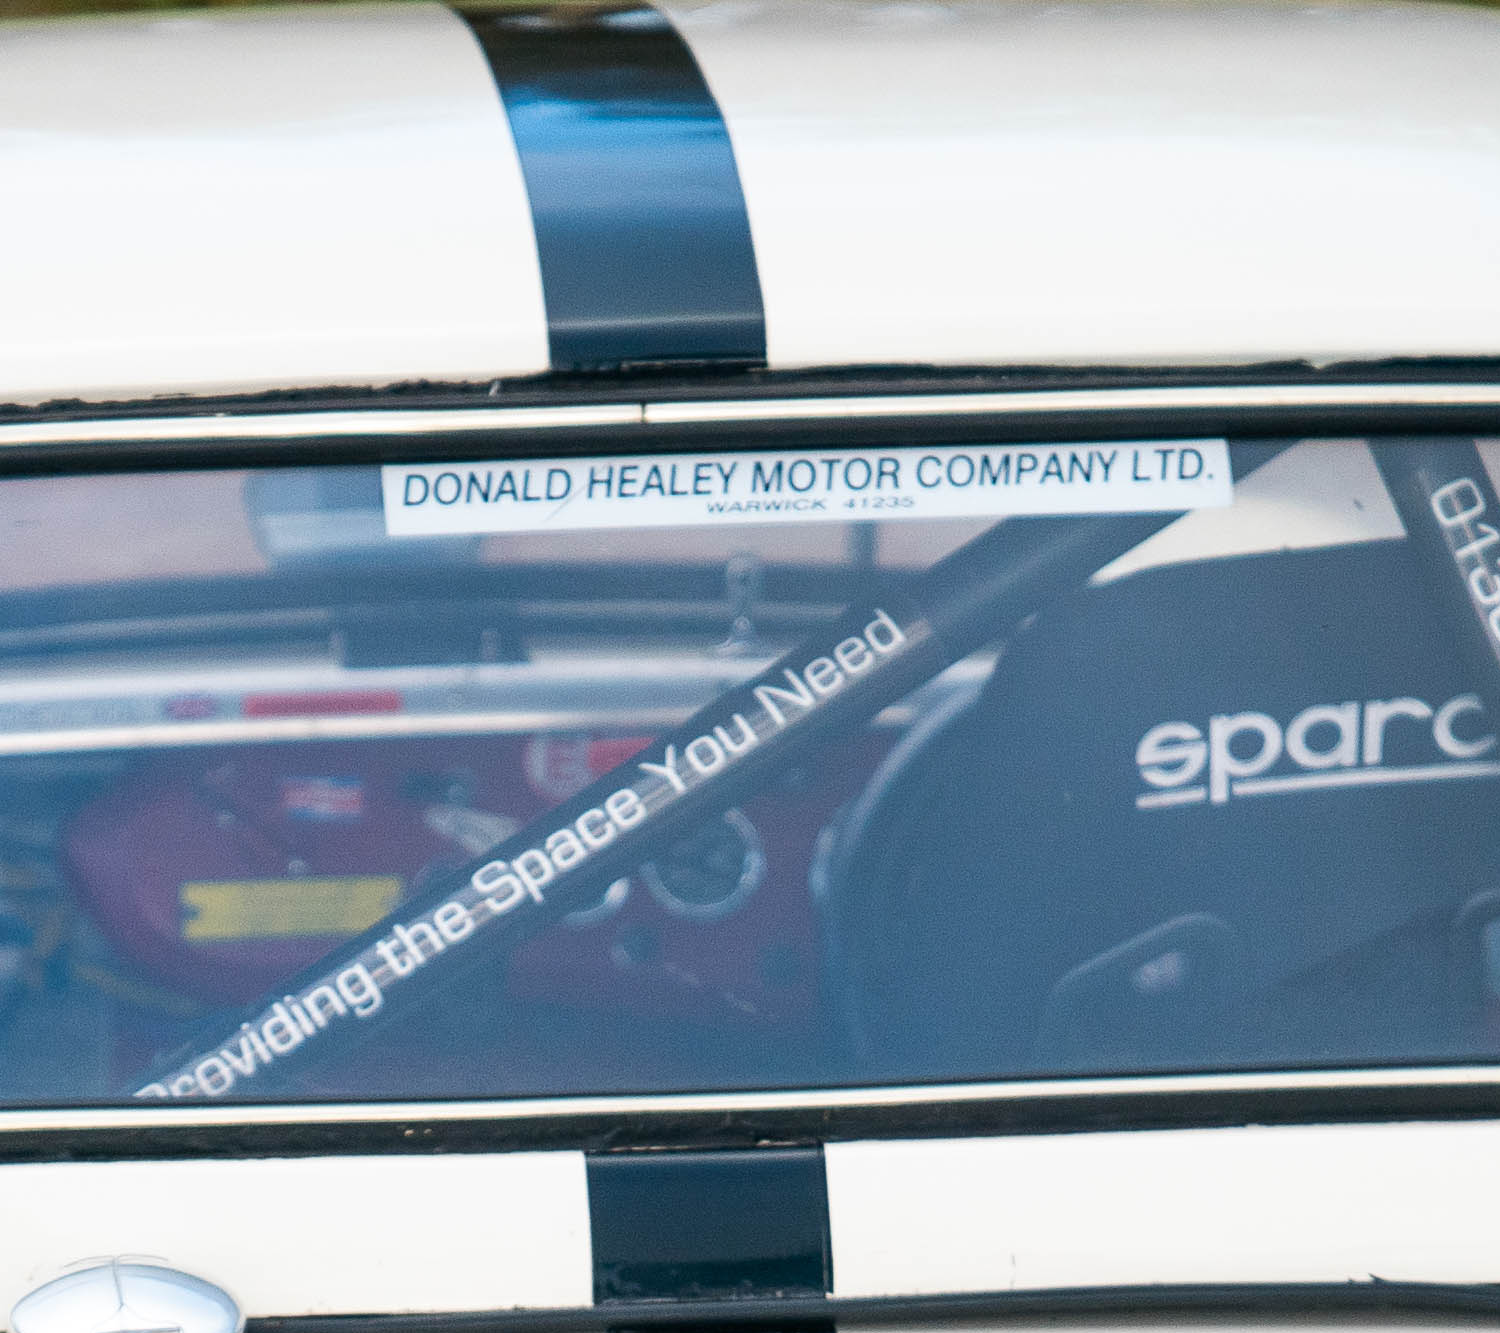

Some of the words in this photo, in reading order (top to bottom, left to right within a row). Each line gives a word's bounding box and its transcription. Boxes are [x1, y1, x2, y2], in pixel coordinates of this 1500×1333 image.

[403, 468, 572, 506] DONALD
[588, 462, 738, 499] HEALEY
[750, 457, 901, 493] MOTOR
[915, 450, 1118, 488] COMPANY
[1131, 448, 1214, 481] LTD.
[705, 497, 827, 514] WARWICK
[842, 495, 915, 510] 41235
[375, 900, 476, 977] the
[470, 788, 648, 914] Space
[638, 713, 760, 796] You
[752, 607, 907, 727] Need
